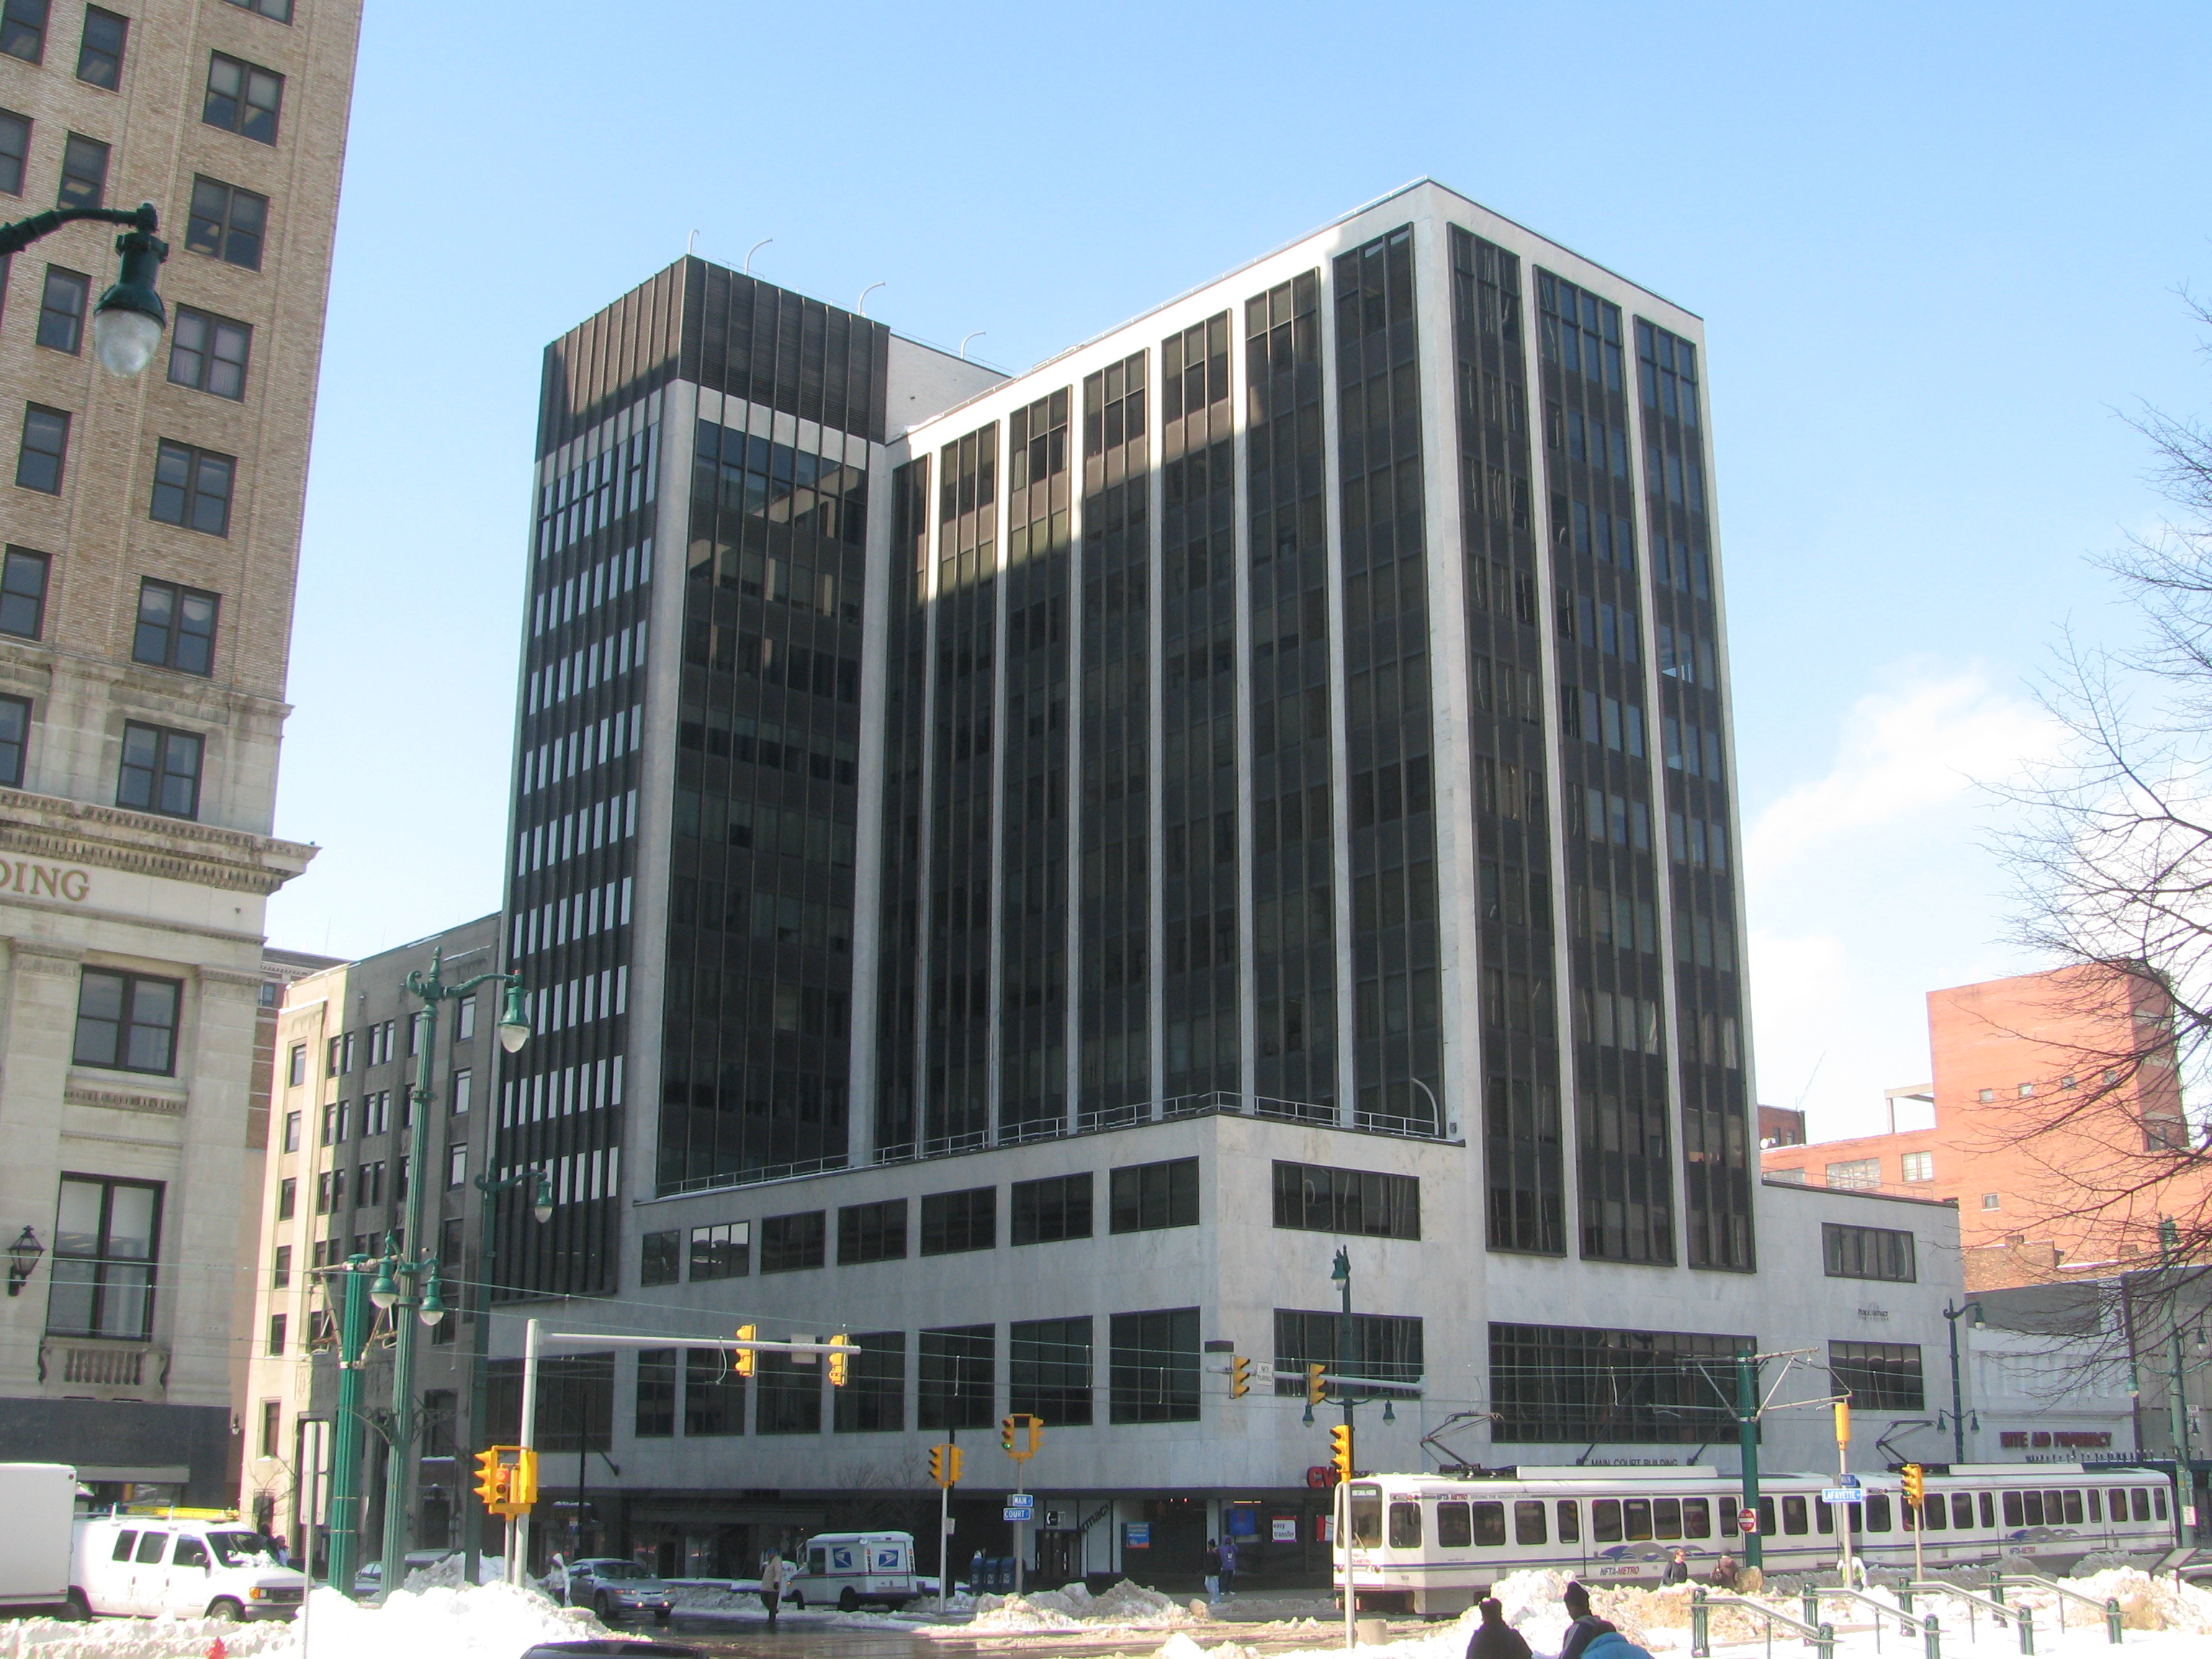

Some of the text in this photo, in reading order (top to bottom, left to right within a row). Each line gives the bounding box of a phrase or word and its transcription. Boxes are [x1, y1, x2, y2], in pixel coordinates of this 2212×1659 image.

[1823, 1490, 1856, 1500] LAFAYETTE
[1014, 1496, 1027, 1505] MAIN
[1004, 1509, 1025, 1518] COURT
[1600, 1566, 1640, 1576] NFTA-METRO
